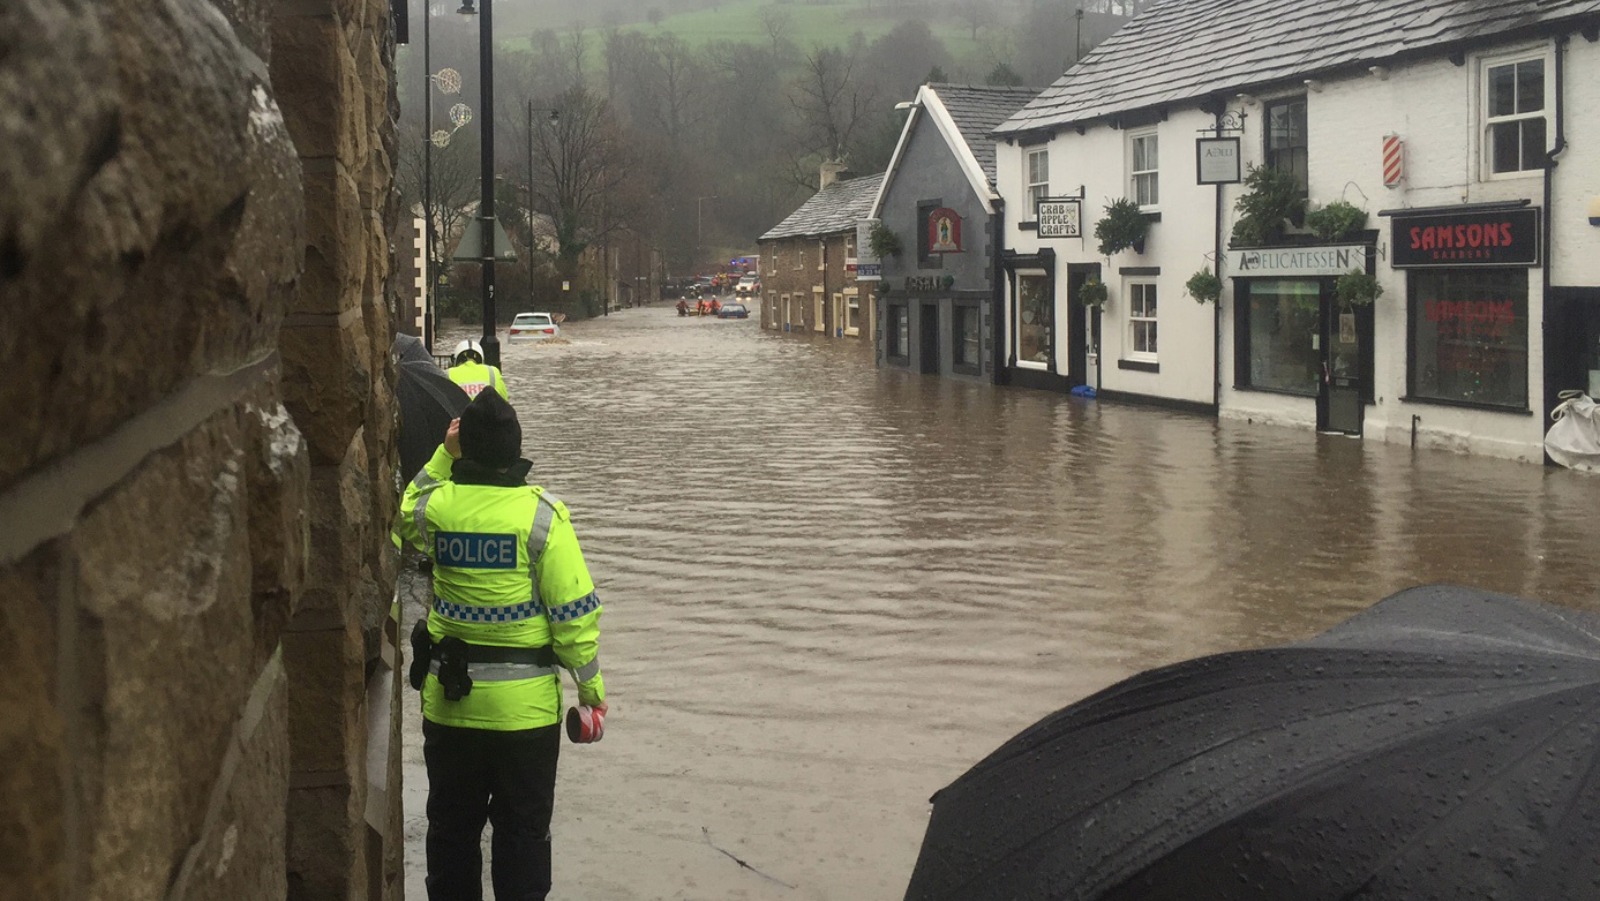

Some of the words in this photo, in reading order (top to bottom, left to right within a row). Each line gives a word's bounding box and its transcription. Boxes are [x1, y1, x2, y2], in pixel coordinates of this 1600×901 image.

[1041, 204, 1065, 215] CRAB
[1041, 214, 1069, 225] APPLE
[1041, 224, 1076, 235] CRAFTS
[1409, 222, 1513, 251] SAMSONS
[437, 537, 513, 564] POLICE
